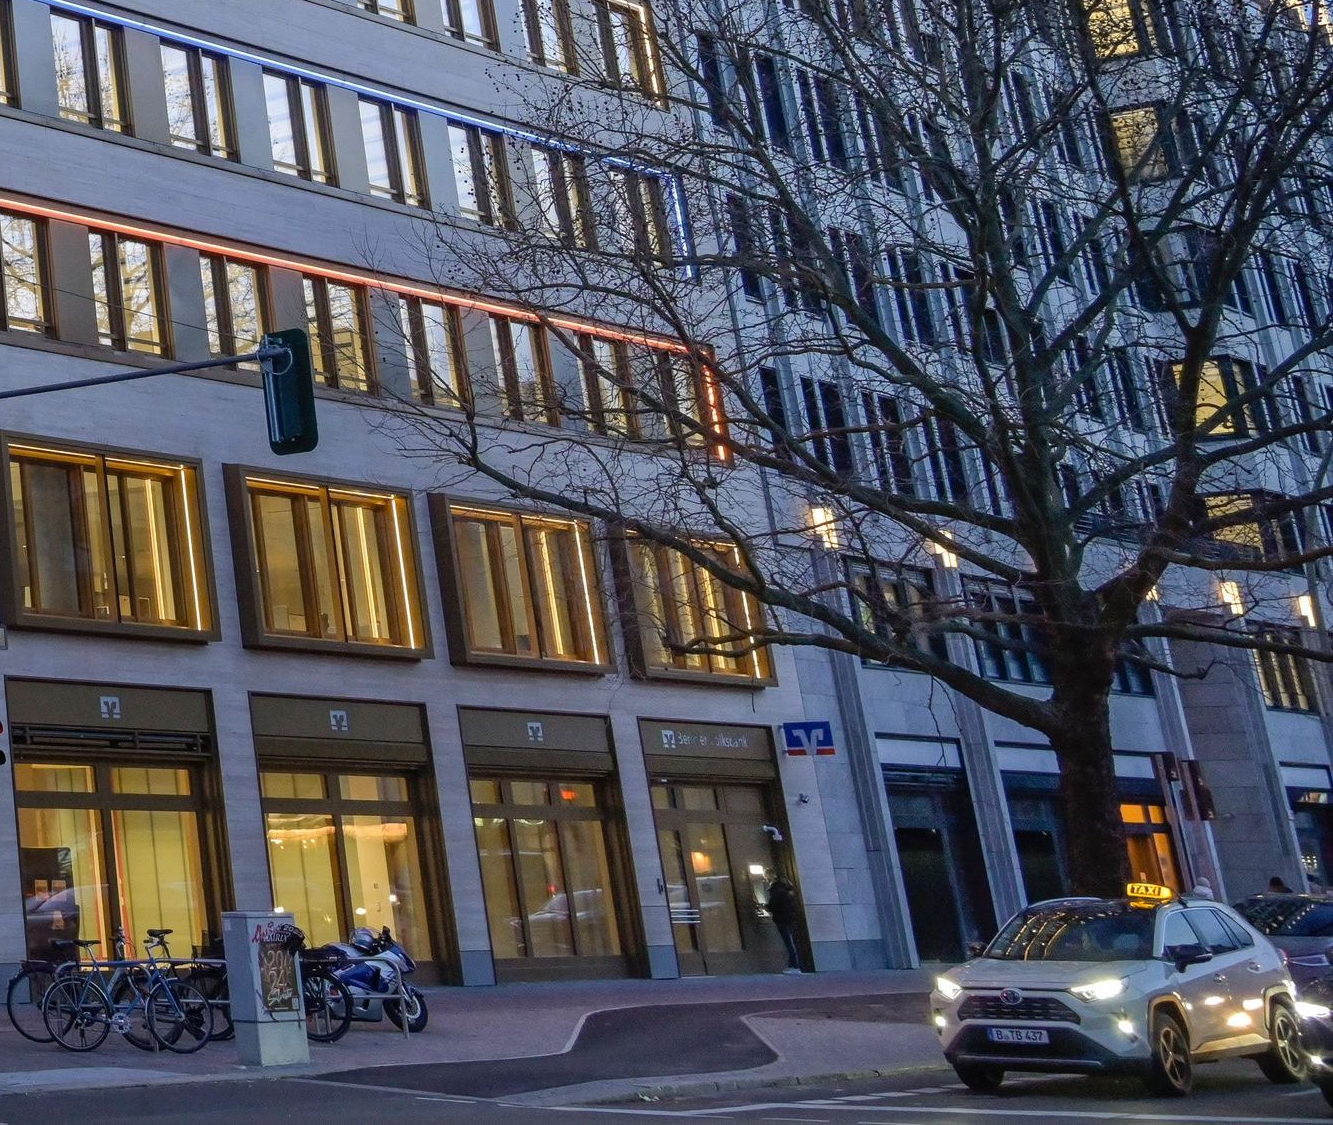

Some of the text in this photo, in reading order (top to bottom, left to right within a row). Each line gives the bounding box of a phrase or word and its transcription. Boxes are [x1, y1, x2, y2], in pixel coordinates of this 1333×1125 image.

[1132, 885, 1161, 896] TAXI
[995, 1029, 1043, 1041] B TB 437
